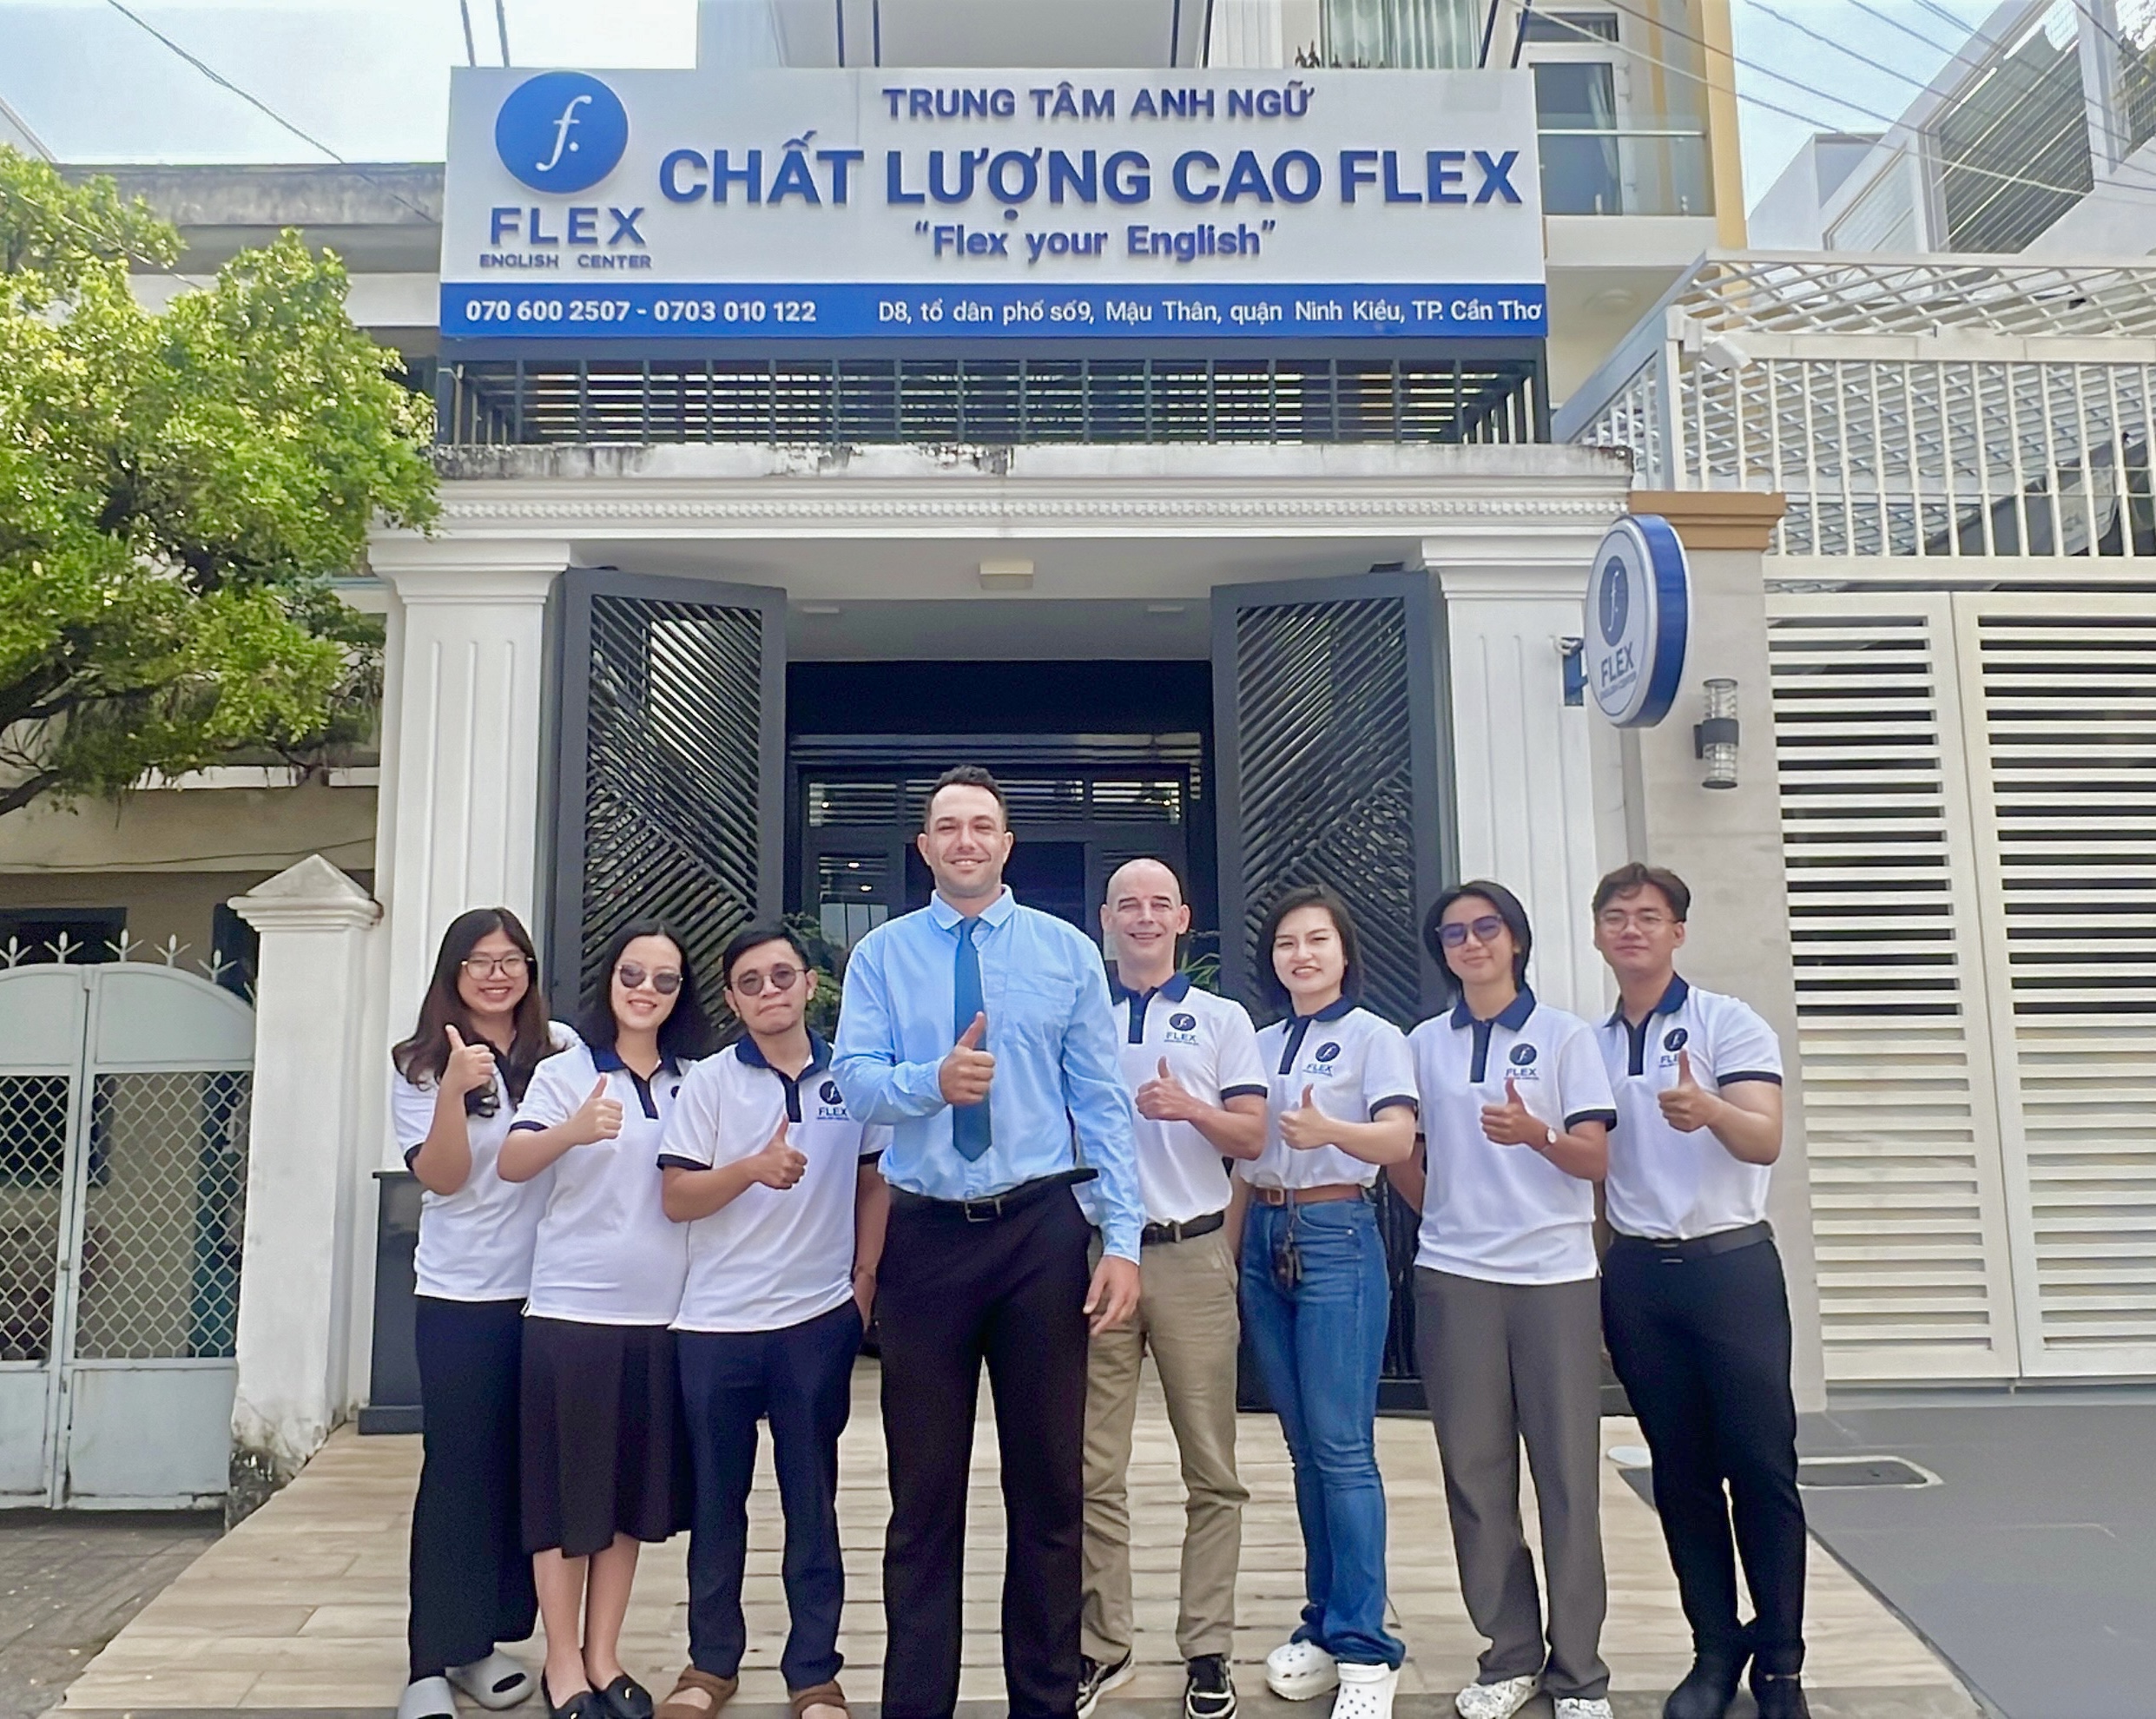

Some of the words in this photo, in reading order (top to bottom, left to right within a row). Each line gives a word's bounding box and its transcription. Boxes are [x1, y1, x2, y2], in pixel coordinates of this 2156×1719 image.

[882, 89, 1016, 118] TRUNG
[1029, 81, 1116, 118] TÂM
[1131, 89, 1215, 118] ANH
[1228, 80, 1315, 118] NGỮ
[659, 130, 865, 204] CHẤT
[887, 147, 1151, 221] LƯỢNG
[1172, 149, 1322, 205] CAO
[1340, 150, 1522, 204] FLEX
[491, 207, 646, 246] FLEX
[479, 254, 560, 269] ENGLISH
[577, 254, 651, 269] CENTER
[1025, 232, 1108, 264] your
[465, 300, 511, 322] 070
[517, 300, 564, 322] 600
[569, 300, 631, 322] 2507
[654, 300, 716, 322] 0703
[723, 300, 767, 322] 010
[773, 300, 816, 322] 122
[879, 301, 912, 325] D8,
[920, 298, 944, 321] tổ
[953, 300, 993, 322] dân
[1003, 299, 1045, 326] phố
[1105, 300, 1153, 326] Mậu
[1162, 300, 1222, 326] Thân,
[1230, 301, 1282, 326] quận
[1295, 300, 1343, 322] Ninh
[1412, 300, 1444, 321] TP.
[1498, 300, 1543, 321] Thơ
[1600, 641, 1634, 688] FLEX
[1166, 1031, 1197, 1043] FLEX
[1506, 1068, 1537, 1077] FLEX
[819, 1106, 847, 1117] FLEX
